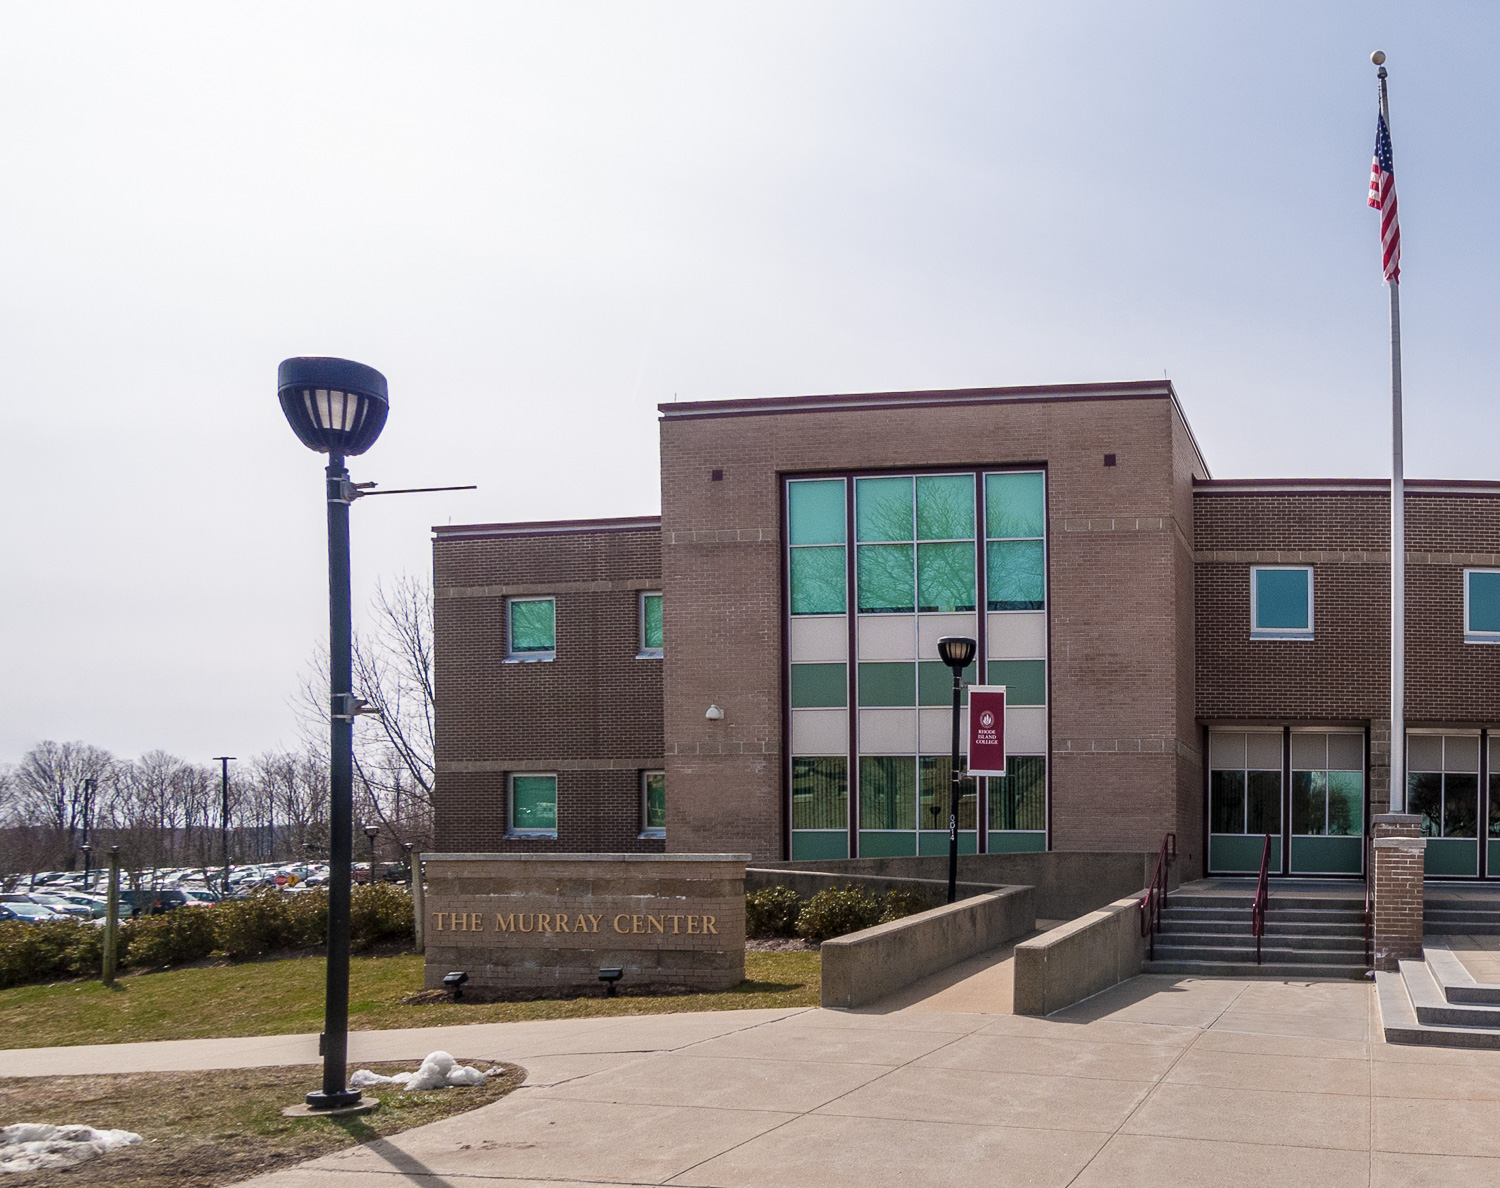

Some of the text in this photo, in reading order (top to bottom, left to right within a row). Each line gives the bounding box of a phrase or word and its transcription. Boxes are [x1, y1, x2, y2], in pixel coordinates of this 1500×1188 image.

[432, 912, 719, 935] THE MURRAY CENTER
